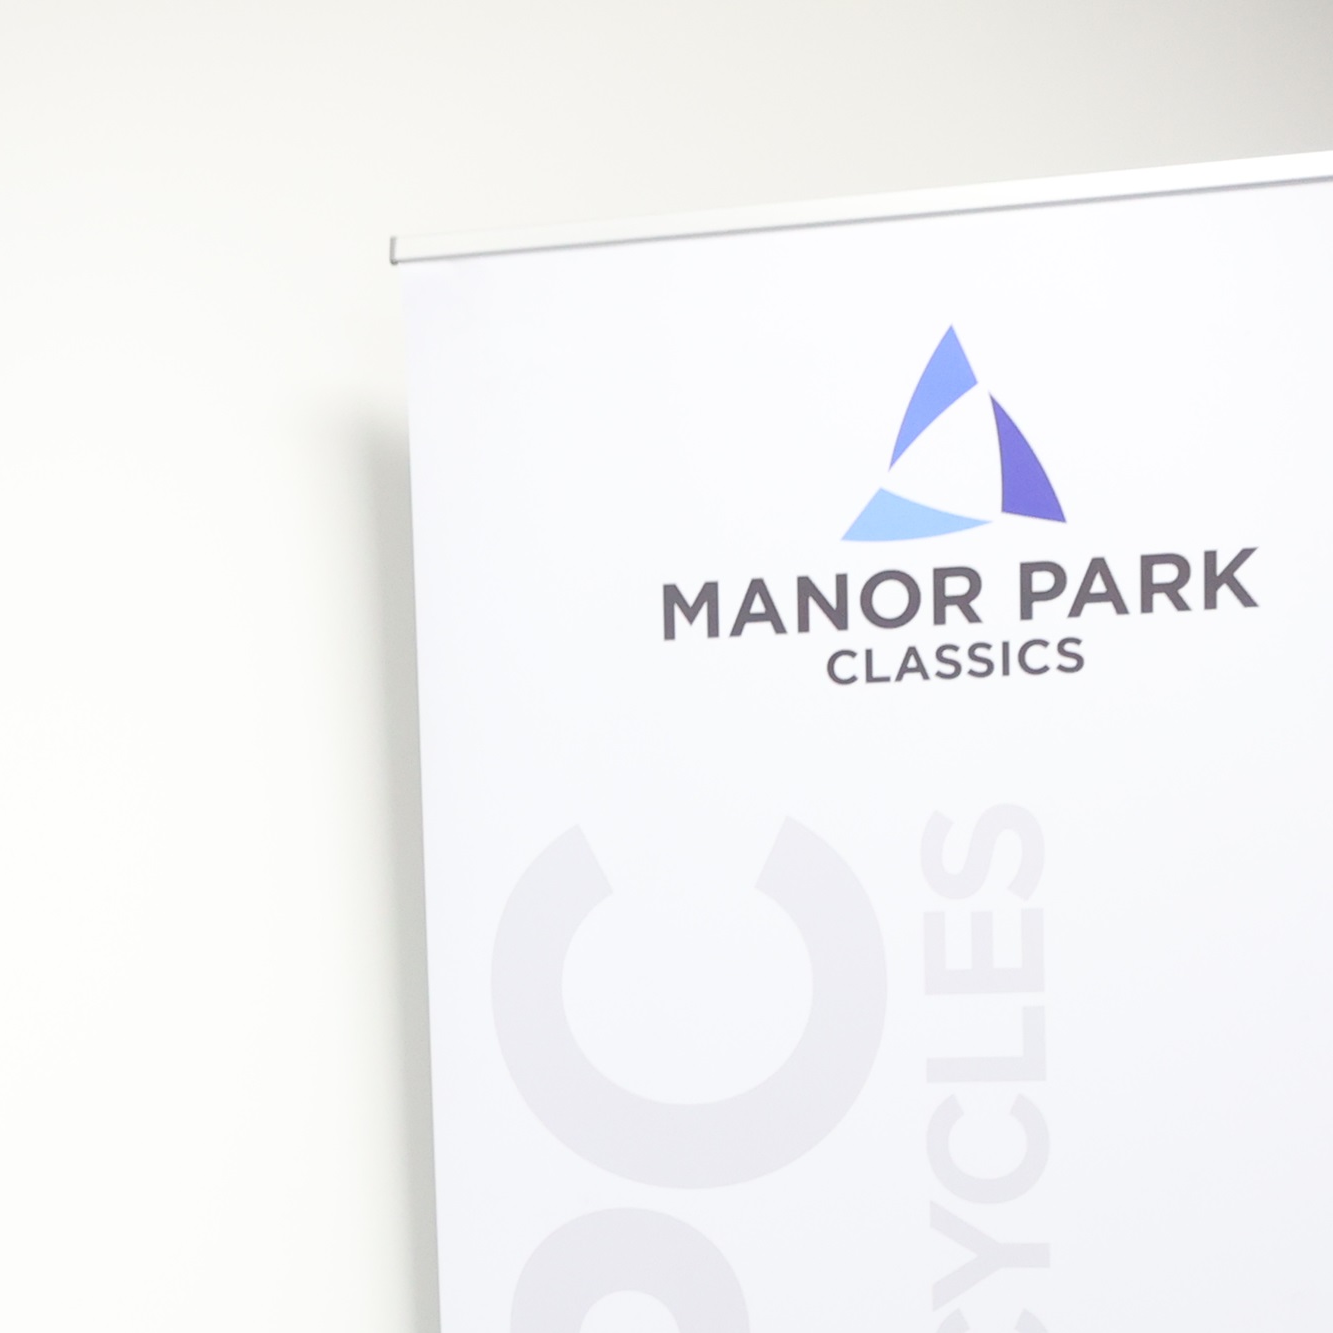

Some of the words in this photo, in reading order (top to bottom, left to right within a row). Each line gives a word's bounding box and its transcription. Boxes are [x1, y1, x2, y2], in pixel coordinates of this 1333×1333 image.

[662, 565, 983, 641] MANOR
[1019, 547, 1259, 621] PARK
[826, 636, 1085, 686] CLASSICS
